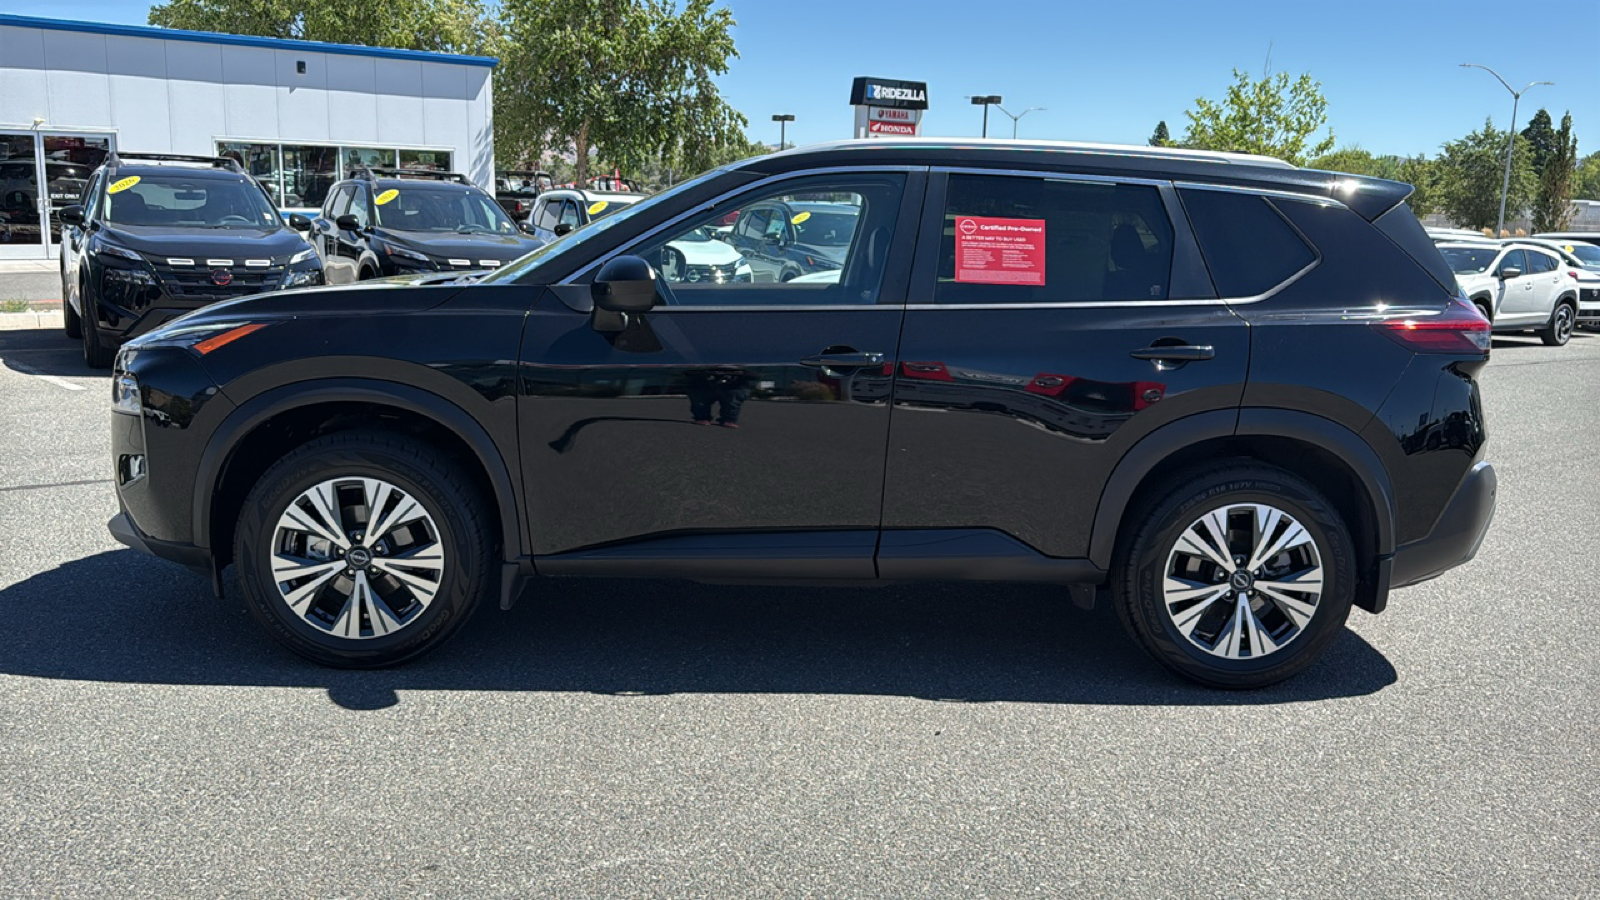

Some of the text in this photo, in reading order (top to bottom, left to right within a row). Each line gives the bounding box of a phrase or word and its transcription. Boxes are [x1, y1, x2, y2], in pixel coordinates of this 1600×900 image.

[882, 87, 926, 101] RIDEZILLA
[885, 110, 909, 120] YAMAHA
[880, 125, 912, 134] HONDA
